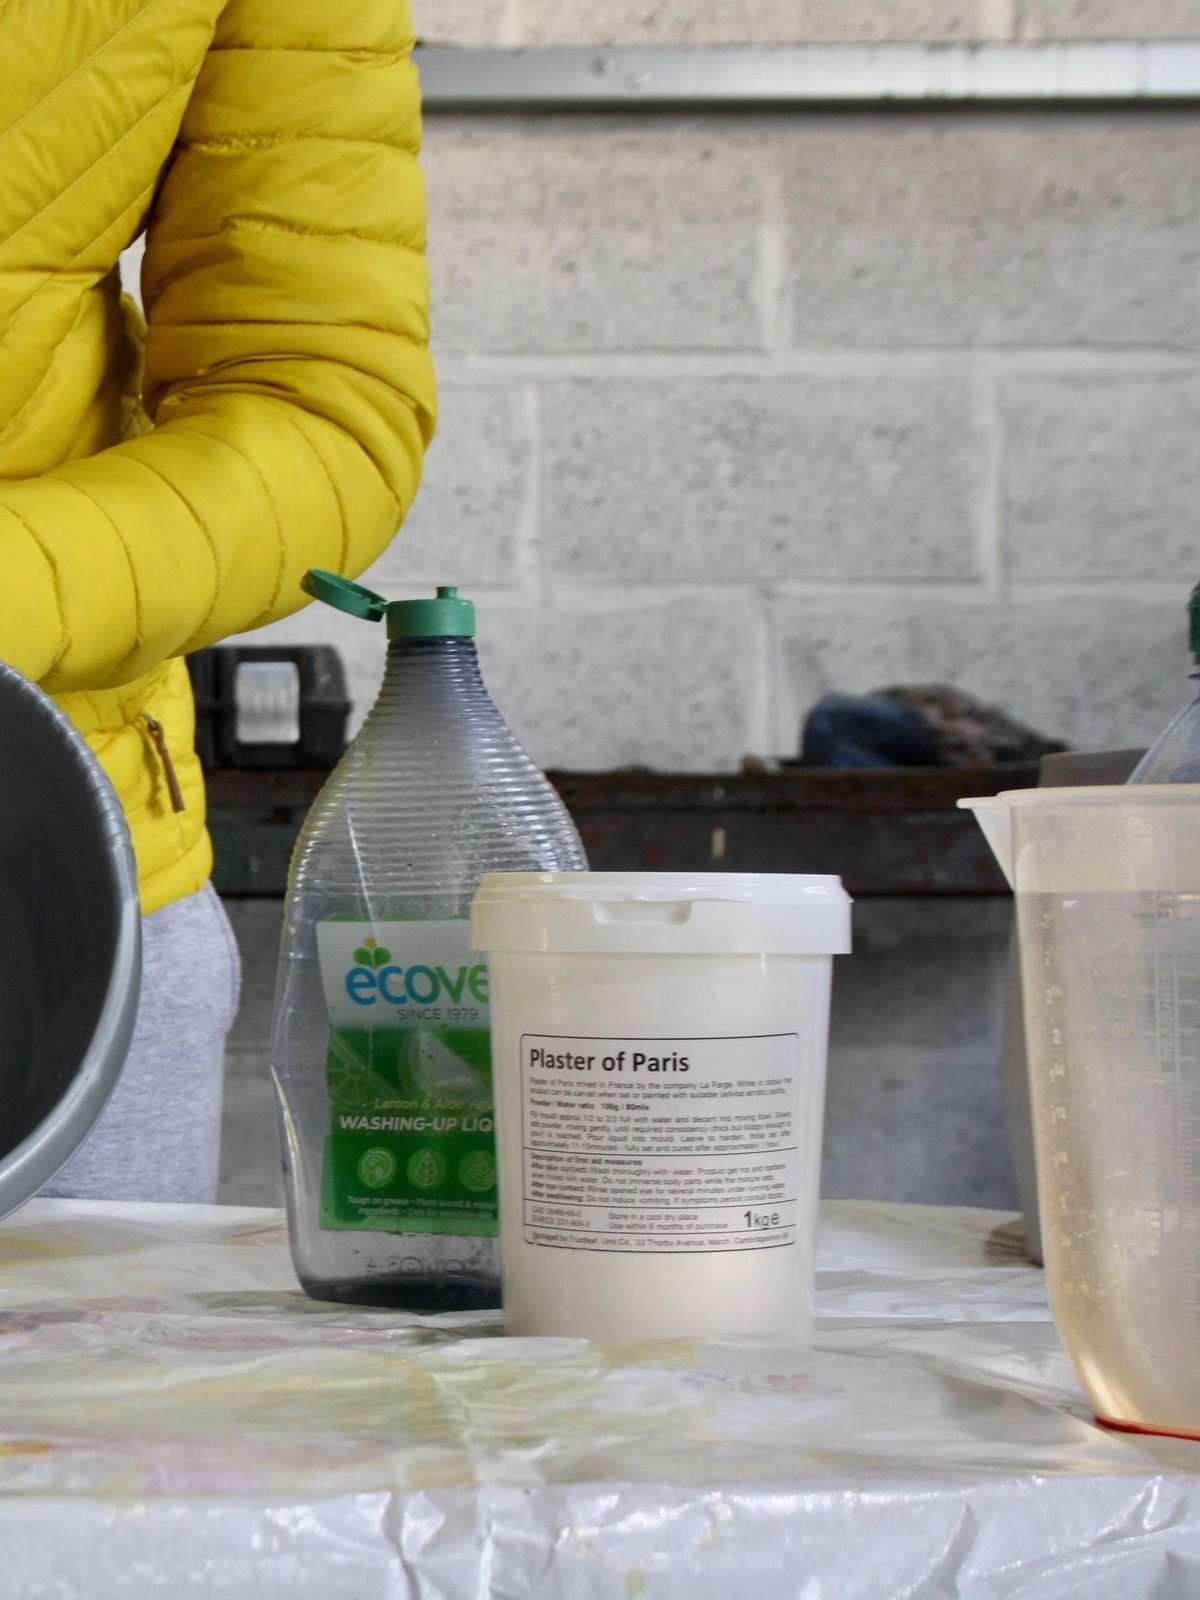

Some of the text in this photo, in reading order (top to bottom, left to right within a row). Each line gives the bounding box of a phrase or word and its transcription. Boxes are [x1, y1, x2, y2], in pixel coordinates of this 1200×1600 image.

[345, 965, 489, 1006] ecove
[398, 1008, 479, 1020] SINCE 1979
[530, 1048, 689, 1072] Plaster of Paris
[608, 1081, 634, 1089] France
[636, 1082, 646, 1090] by
[374, 1100, 418, 1109] Lemon
[420, 1100, 430, 1109] &
[434, 1100, 464, 1109] Aloe
[600, 1102, 619, 1111] 100g
[340, 1116, 458, 1131] WASHING-UP
[632, 1126, 663, 1134] required
[625, 1144, 640, 1153] fully
[602, 1176, 613, 1184] Do
[663, 1178, 681, 1187] body
[609, 1212, 628, 1220] Store
[664, 1214, 676, 1222] dry
[678, 1214, 698, 1222] place
[626, 1222, 647, 1230] within
[686, 1222, 695, 1230] of
